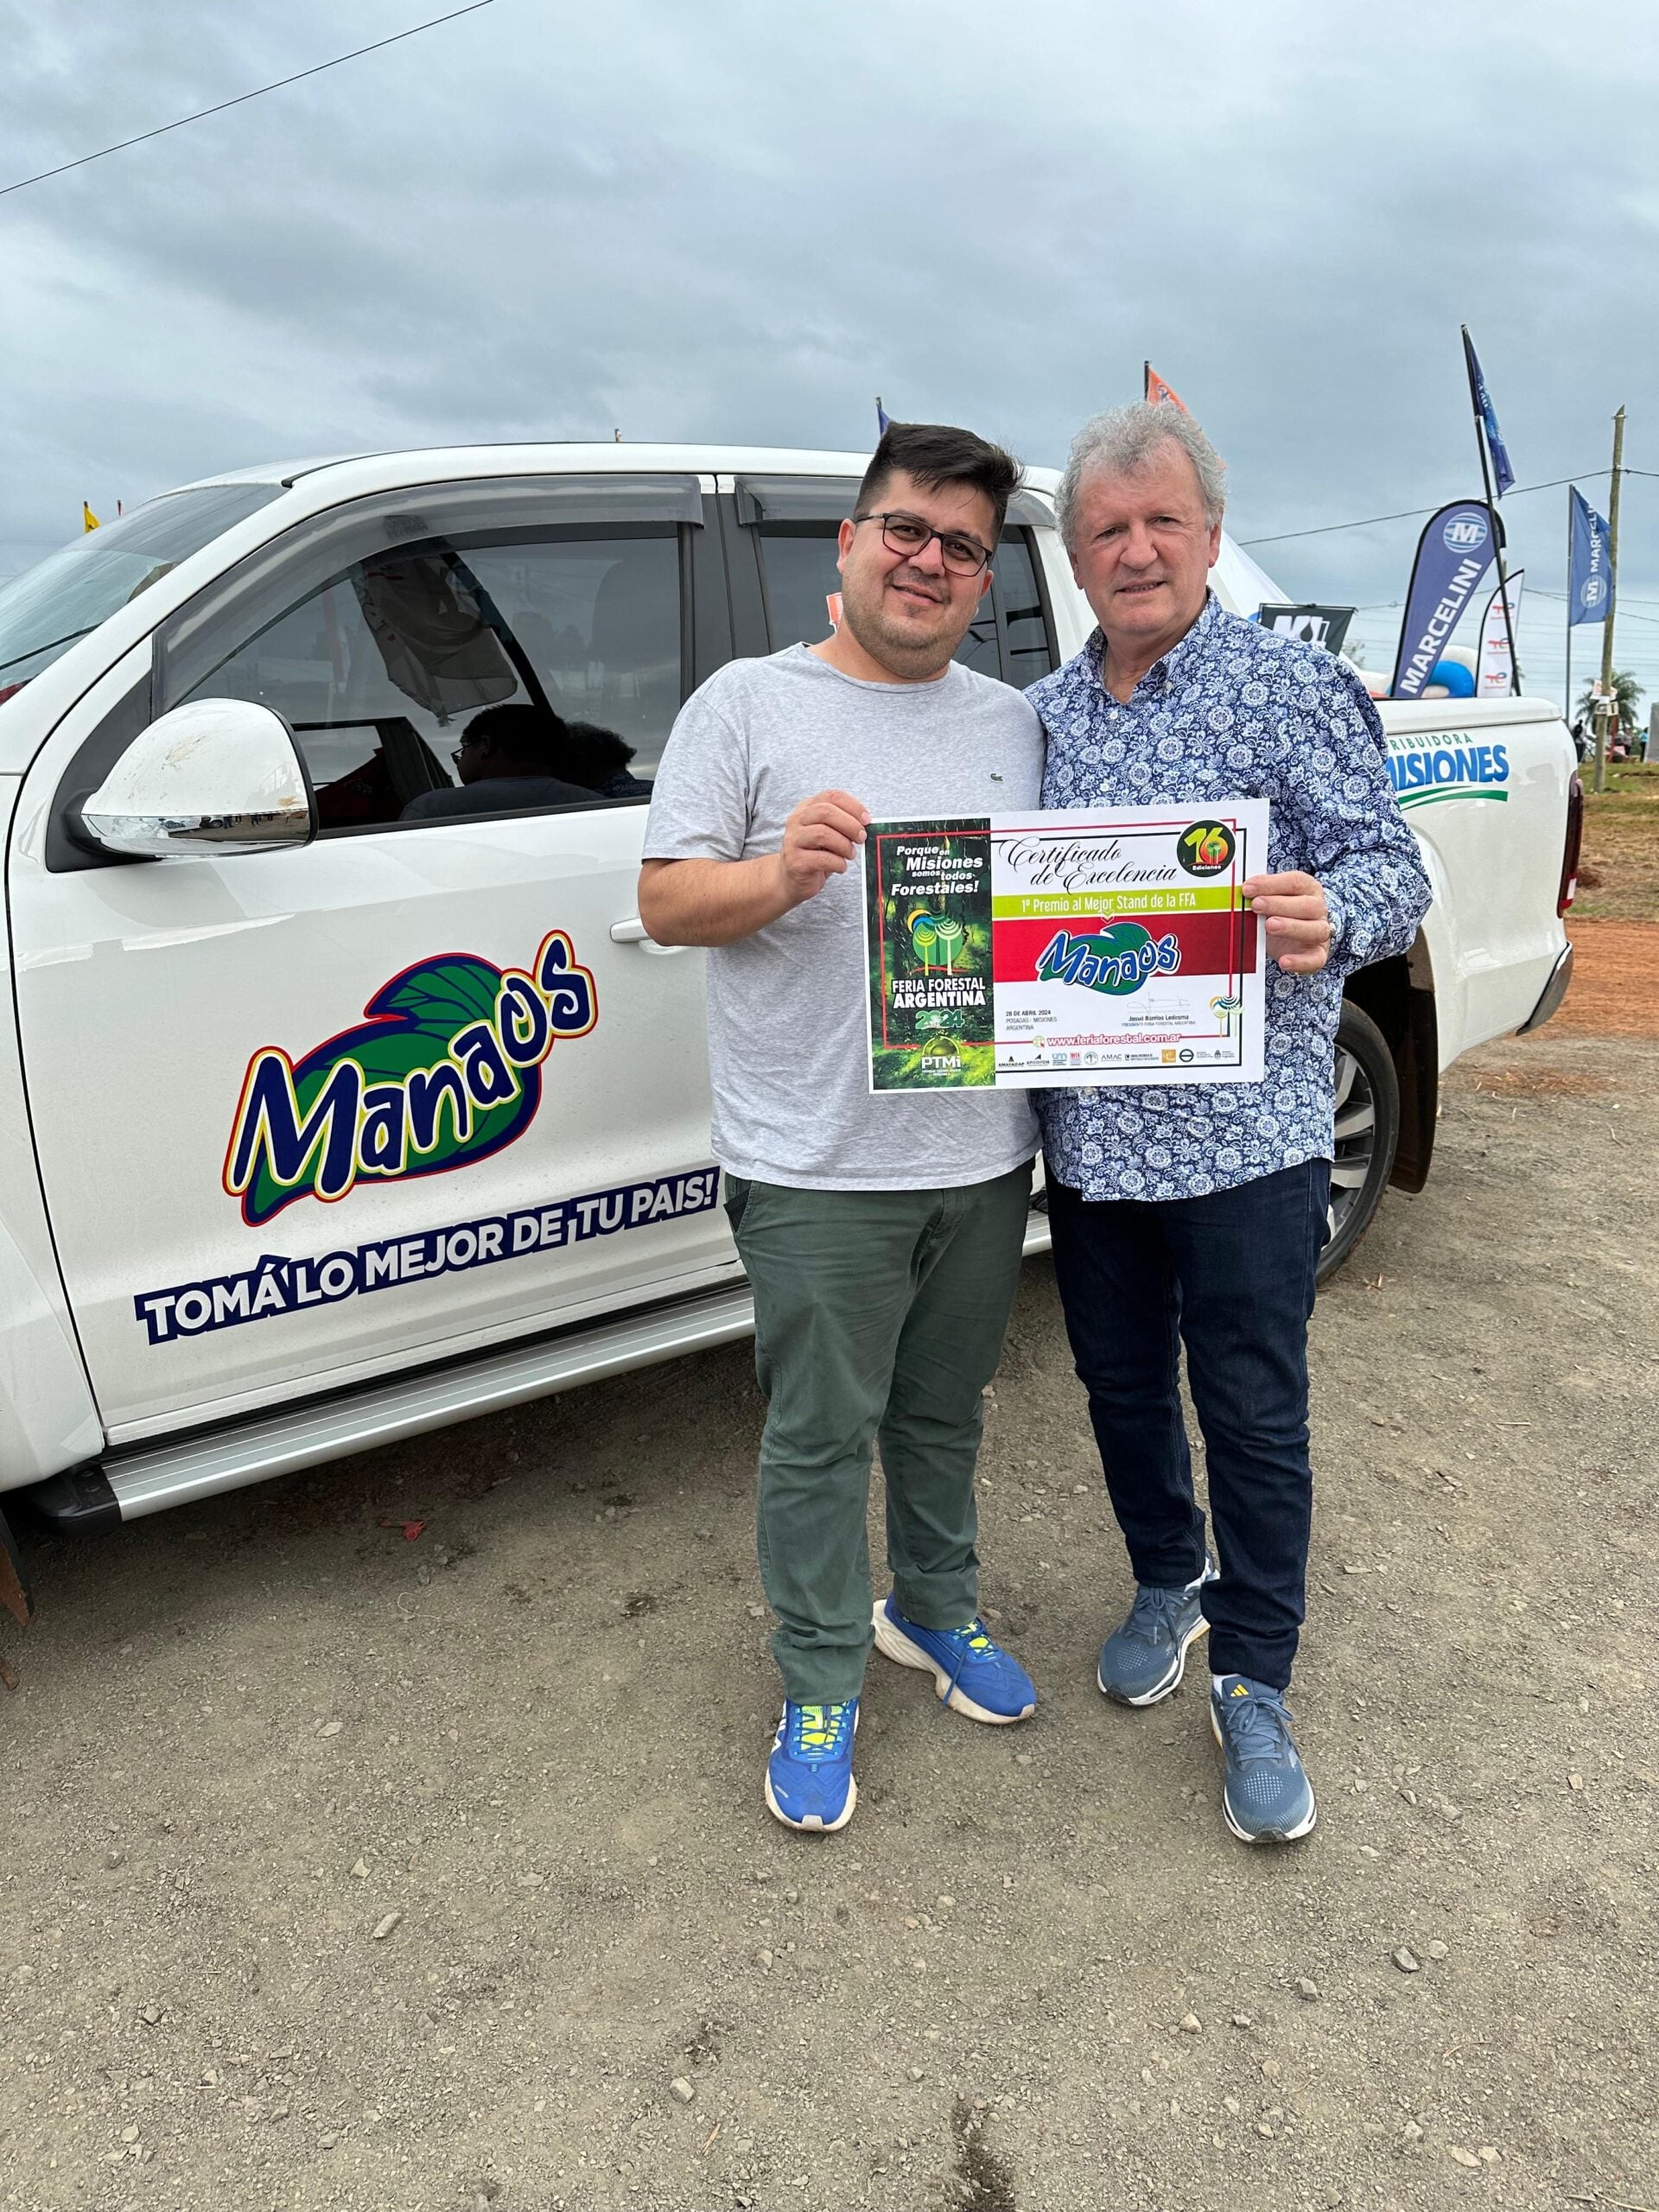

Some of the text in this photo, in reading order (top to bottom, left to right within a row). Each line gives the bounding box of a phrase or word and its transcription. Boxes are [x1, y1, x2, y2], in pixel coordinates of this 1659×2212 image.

[1400, 558, 1483, 694] MARCELINI
[1389, 734, 1473, 751] RIBUIDORA
[897, 846, 939, 856] Porque
[1184, 827, 1229, 864] 16
[906, 856, 983, 871] Misiones
[999, 836, 1122, 878] Certificado
[940, 871, 972, 880] todos
[1030, 861, 1178, 895] de Excelencia
[891, 880, 979, 896] Forestales!
[1033, 896, 1070, 912] Premio
[1072, 897, 1082, 911] al
[1084, 896, 1114, 914] Mejor
[1116, 894, 1148, 909] Stand
[1151, 893, 1163, 907] de
[1166, 893, 1176, 907] la
[1179, 893, 1196, 907] FFA
[1039, 931, 1179, 987] Manaos
[892, 977, 985, 993] FERIA FORESTAL
[893, 990, 986, 1008] ARGENTINA
[1046, 1032, 1181, 1047] www.feriaforestal.com.ar
[230, 933, 593, 1196] Manaos
[144, 1262, 287, 1337] TOMÁ
[296, 1258, 354, 1304] LO
[365, 1222, 505, 1287] MEJOR
[512, 1208, 563, 1252] DE
[631, 1173, 715, 1223] PAIS!
